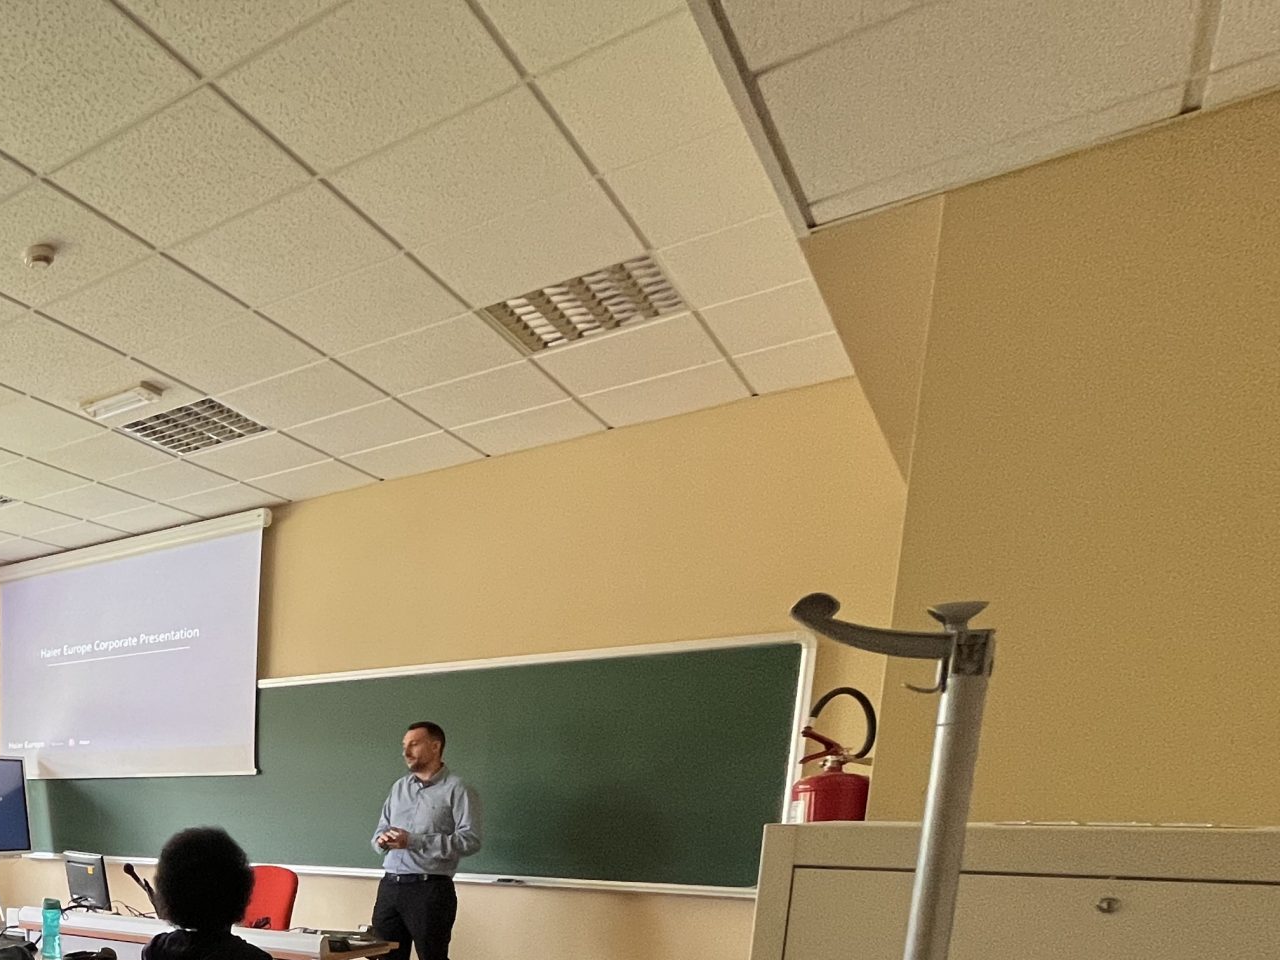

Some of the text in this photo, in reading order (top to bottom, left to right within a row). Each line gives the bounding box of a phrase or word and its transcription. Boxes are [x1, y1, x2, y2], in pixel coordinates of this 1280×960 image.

[40, 627, 200, 659] Haier Europe Corporate Presentation
